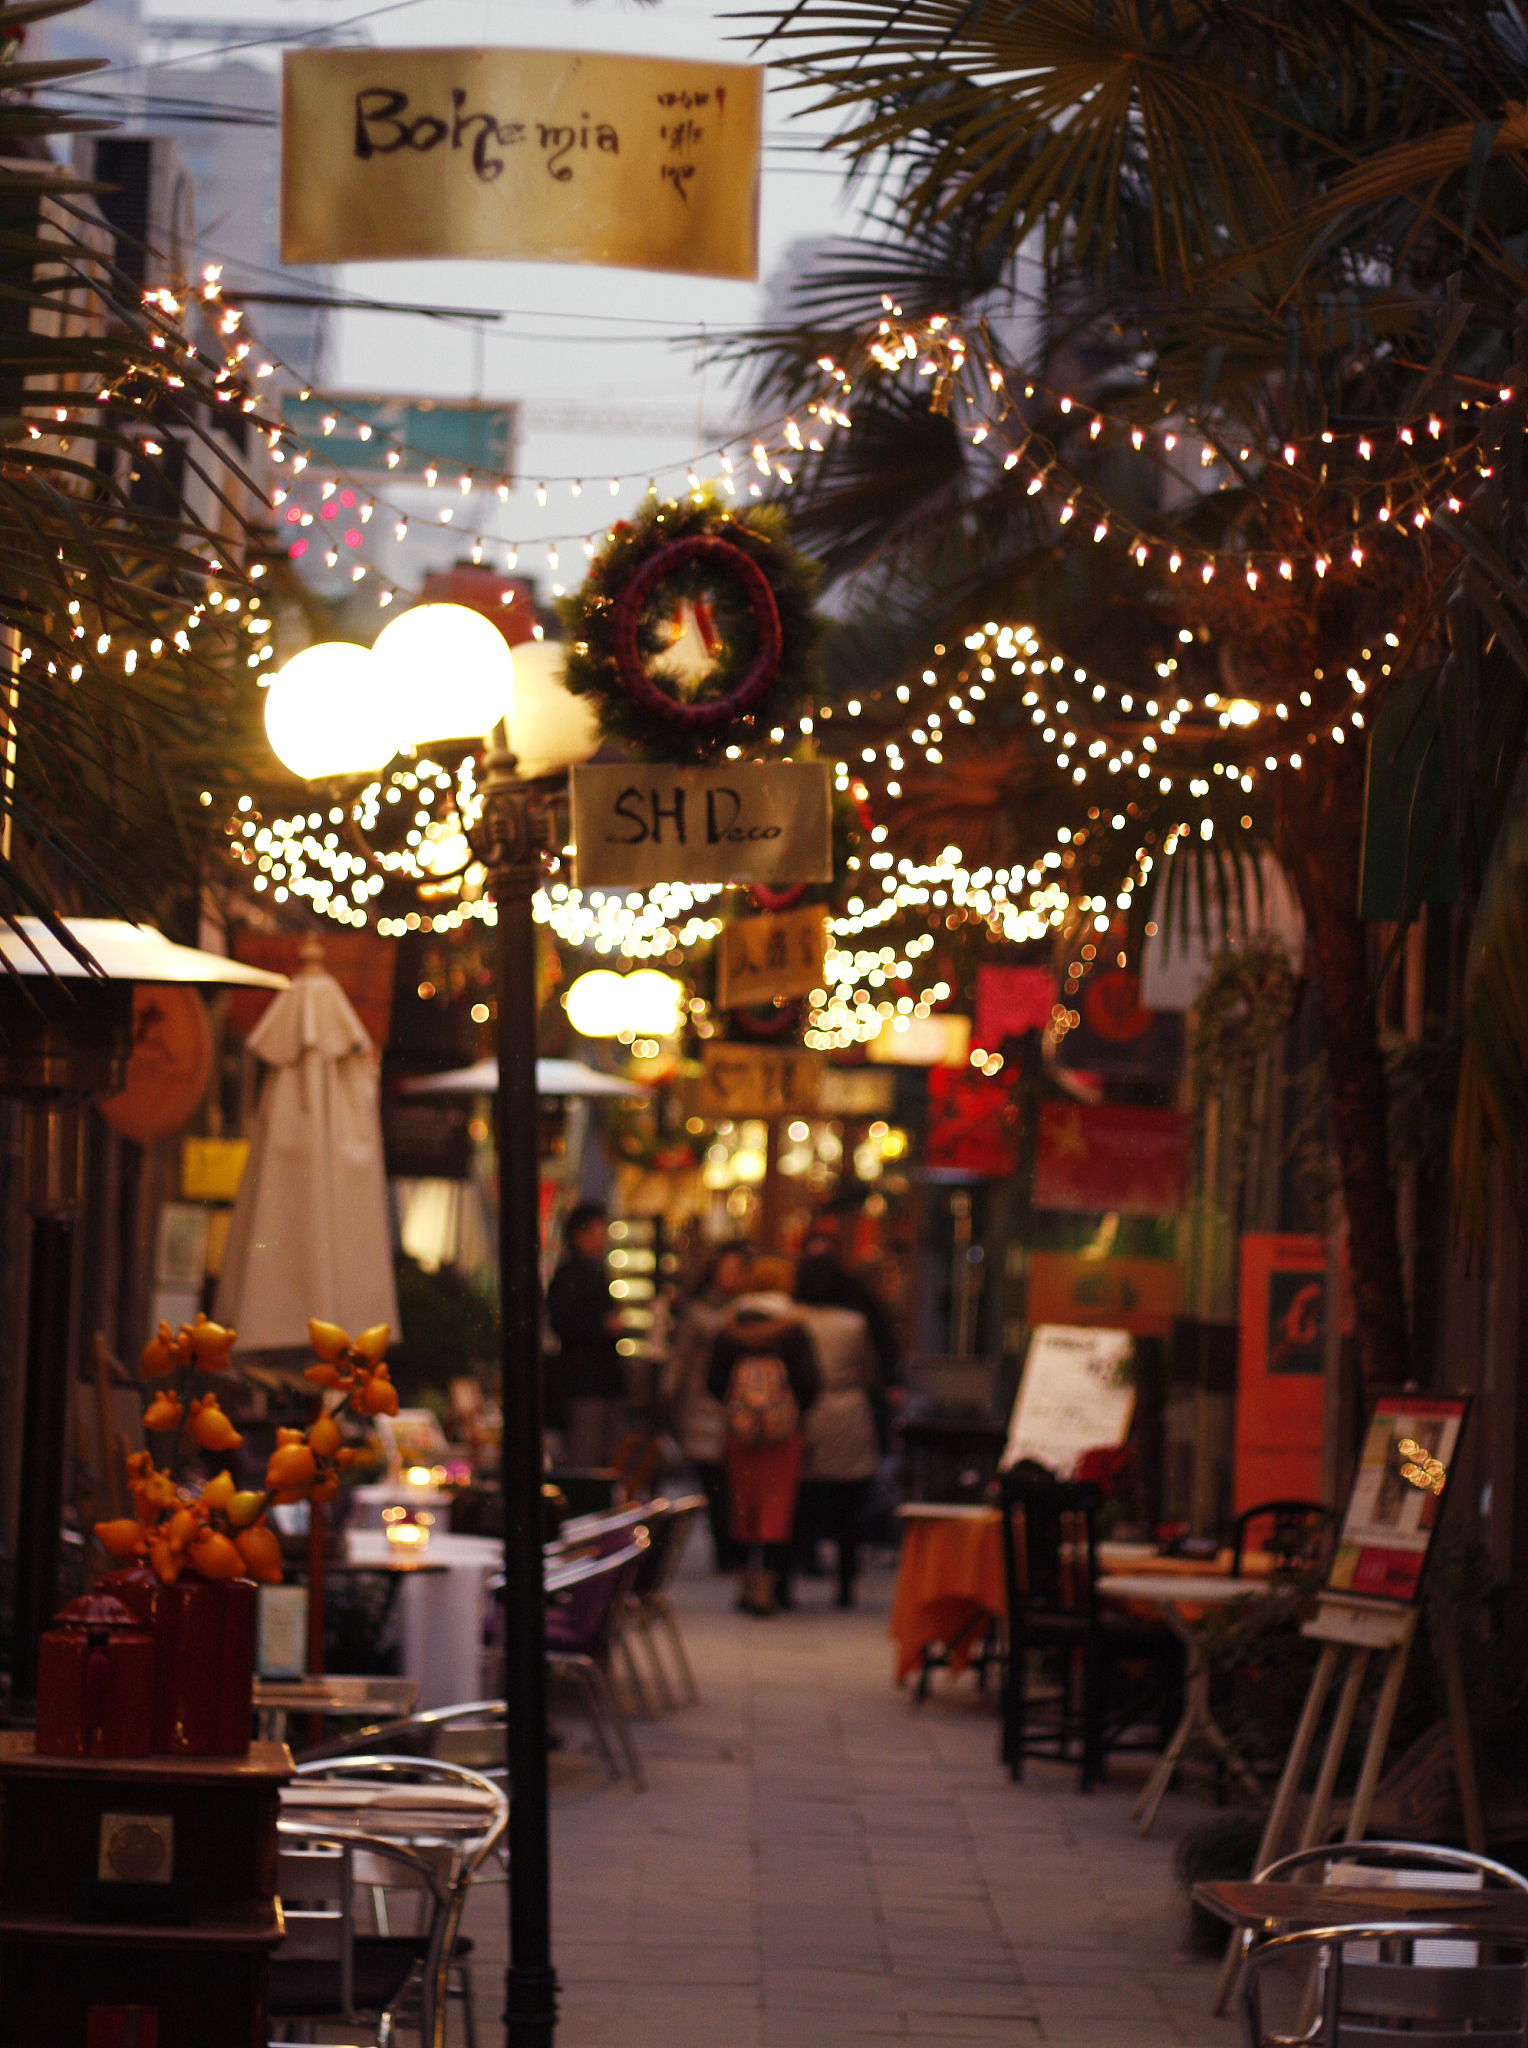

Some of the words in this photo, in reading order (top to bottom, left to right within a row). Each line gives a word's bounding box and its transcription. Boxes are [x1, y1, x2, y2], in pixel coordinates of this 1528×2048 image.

[354, 88, 619, 182] Bohemia
[606, 786, 687, 844] SH
[706, 788, 782, 845] Deco
